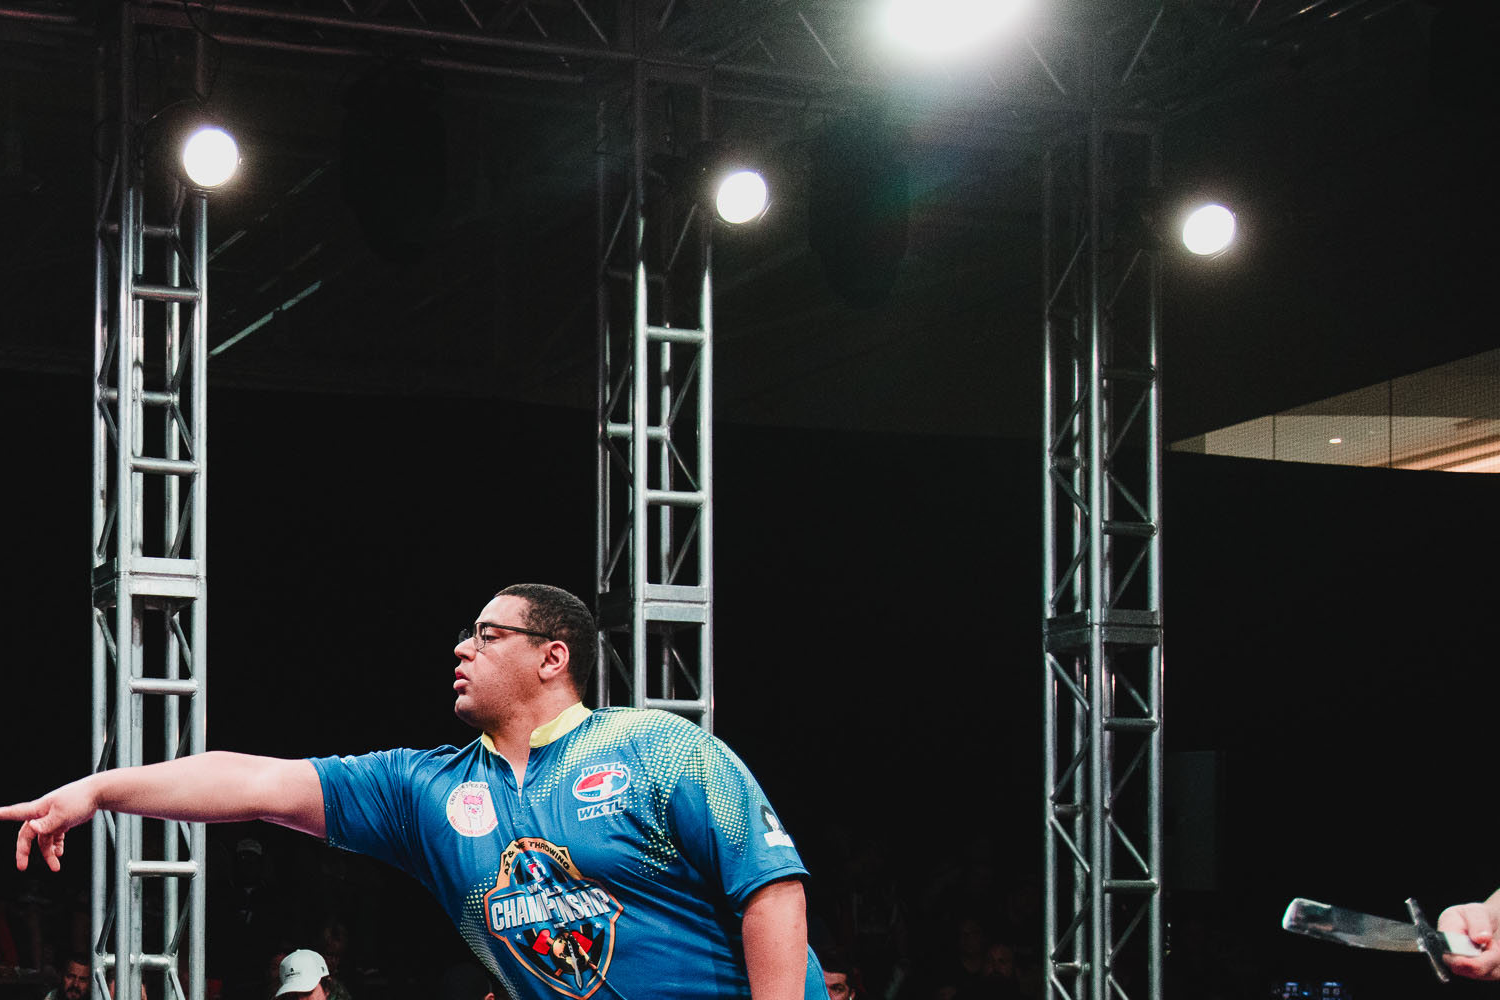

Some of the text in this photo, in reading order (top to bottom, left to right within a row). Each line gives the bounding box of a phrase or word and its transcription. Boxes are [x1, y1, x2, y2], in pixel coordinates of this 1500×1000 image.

[583, 762, 624, 777] WATL
[578, 799, 625, 820] WKTL
[527, 840, 570, 871] THROWING
[526, 882, 564, 898] WLD
[491, 888, 611, 931] CHAMPNSHIP
